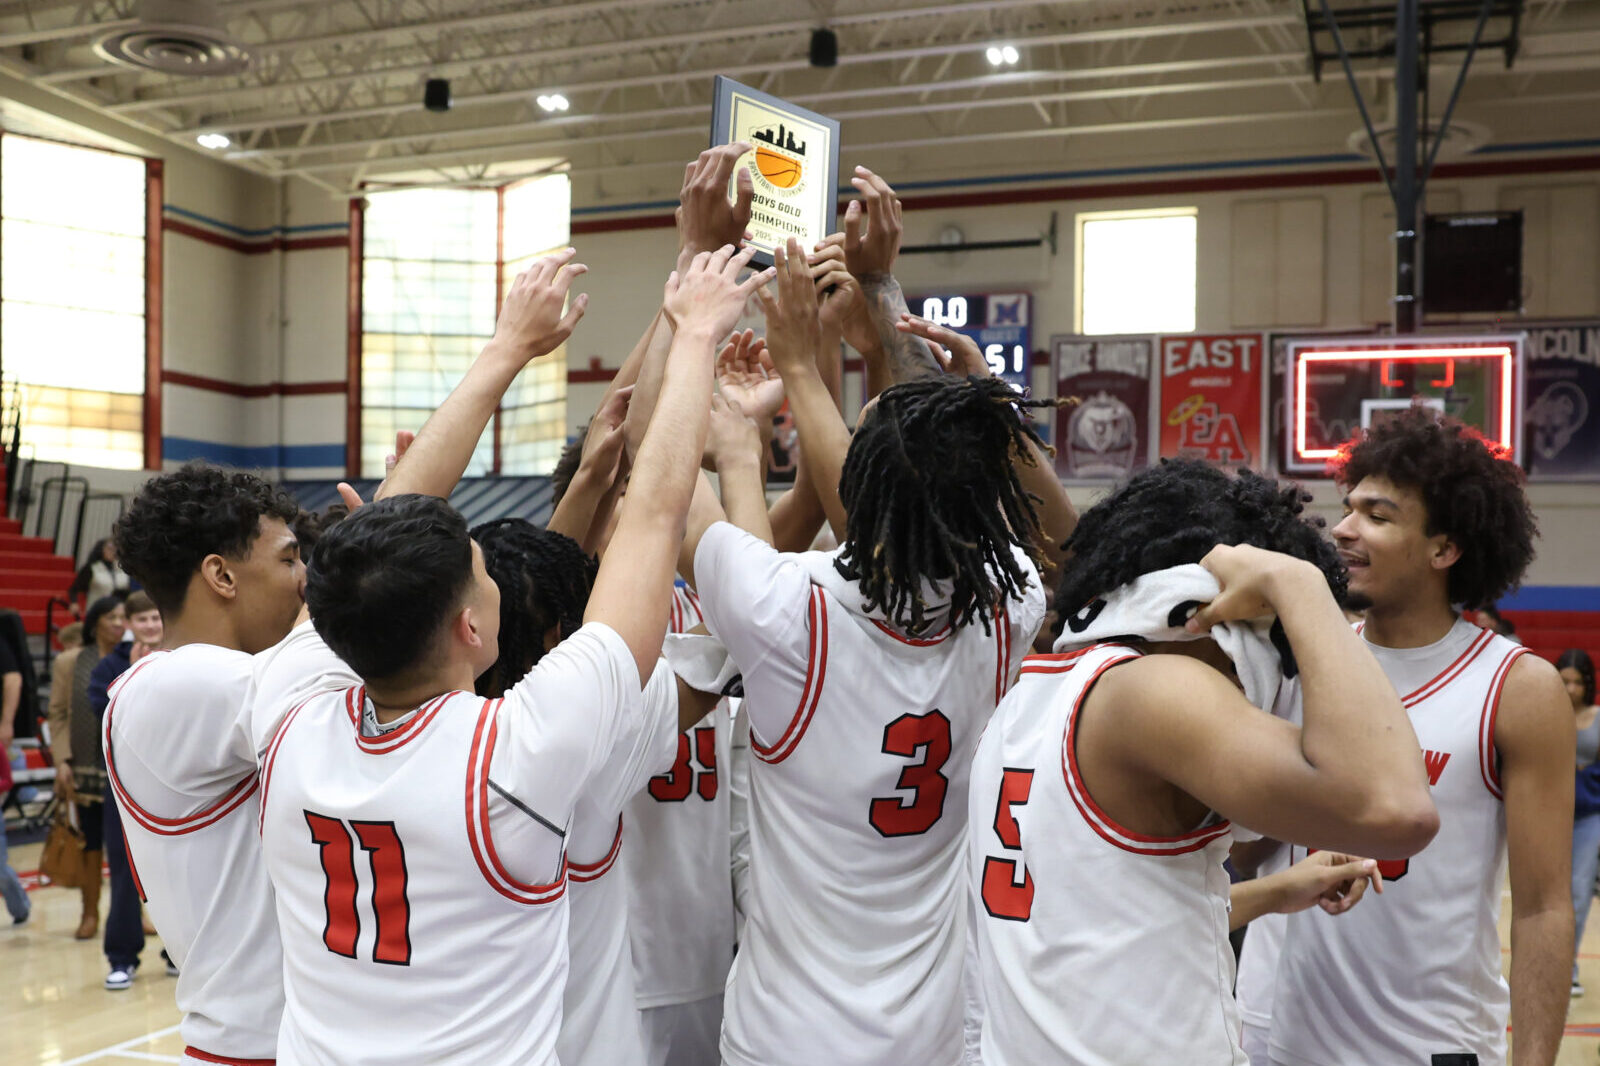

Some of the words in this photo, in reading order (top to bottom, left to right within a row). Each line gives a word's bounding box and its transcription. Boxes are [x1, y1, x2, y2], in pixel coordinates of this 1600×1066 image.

[750, 208, 807, 238] HAMPIONS
[752, 193, 776, 208] BOYS
[778, 202, 802, 218] GOLD
[985, 344, 1023, 375] 51
[1164, 338, 1257, 377] EAST
[1526, 329, 1600, 367] NCOLN
[869, 708, 953, 838] 3
[980, 766, 1036, 923] 5
[302, 808, 412, 967] 11
